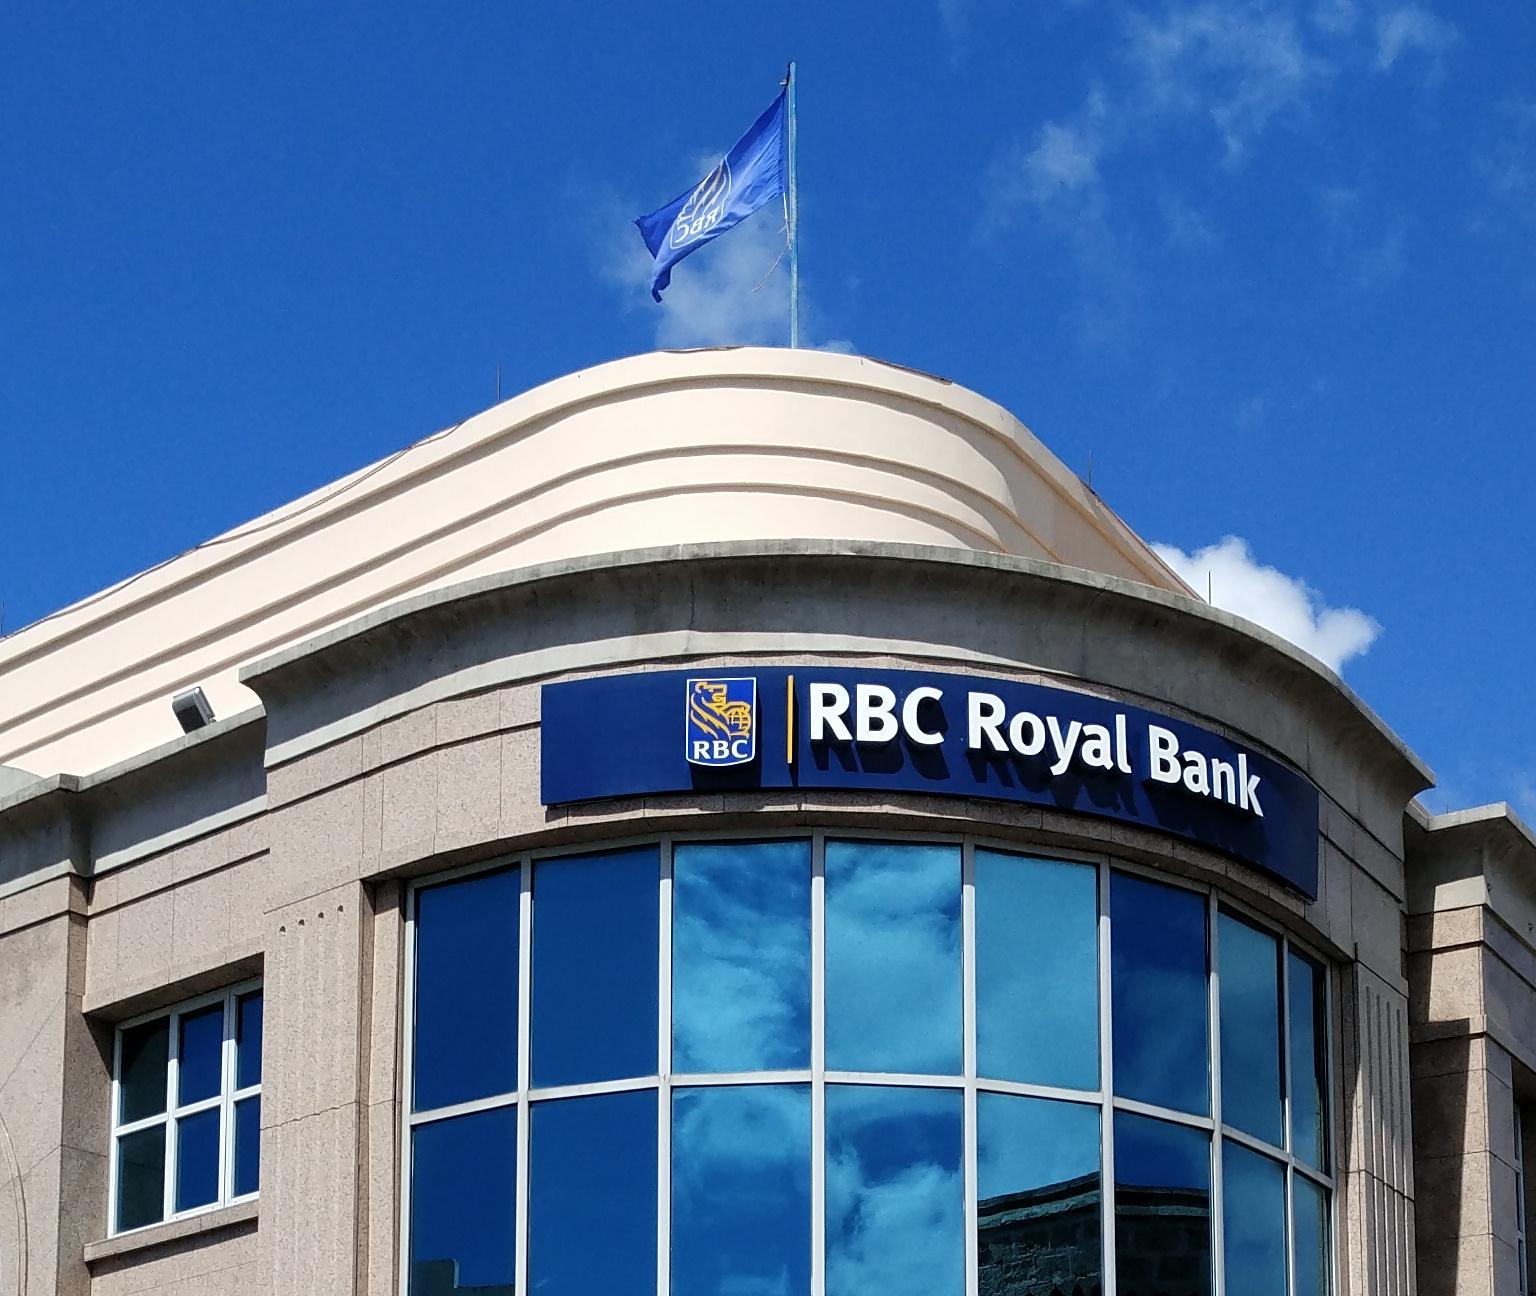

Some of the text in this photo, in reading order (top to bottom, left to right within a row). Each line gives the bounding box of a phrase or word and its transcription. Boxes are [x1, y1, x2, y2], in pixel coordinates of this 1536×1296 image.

[693, 738, 748, 760] RBC
[810, 683, 1265, 817] RBC Royal Bank
